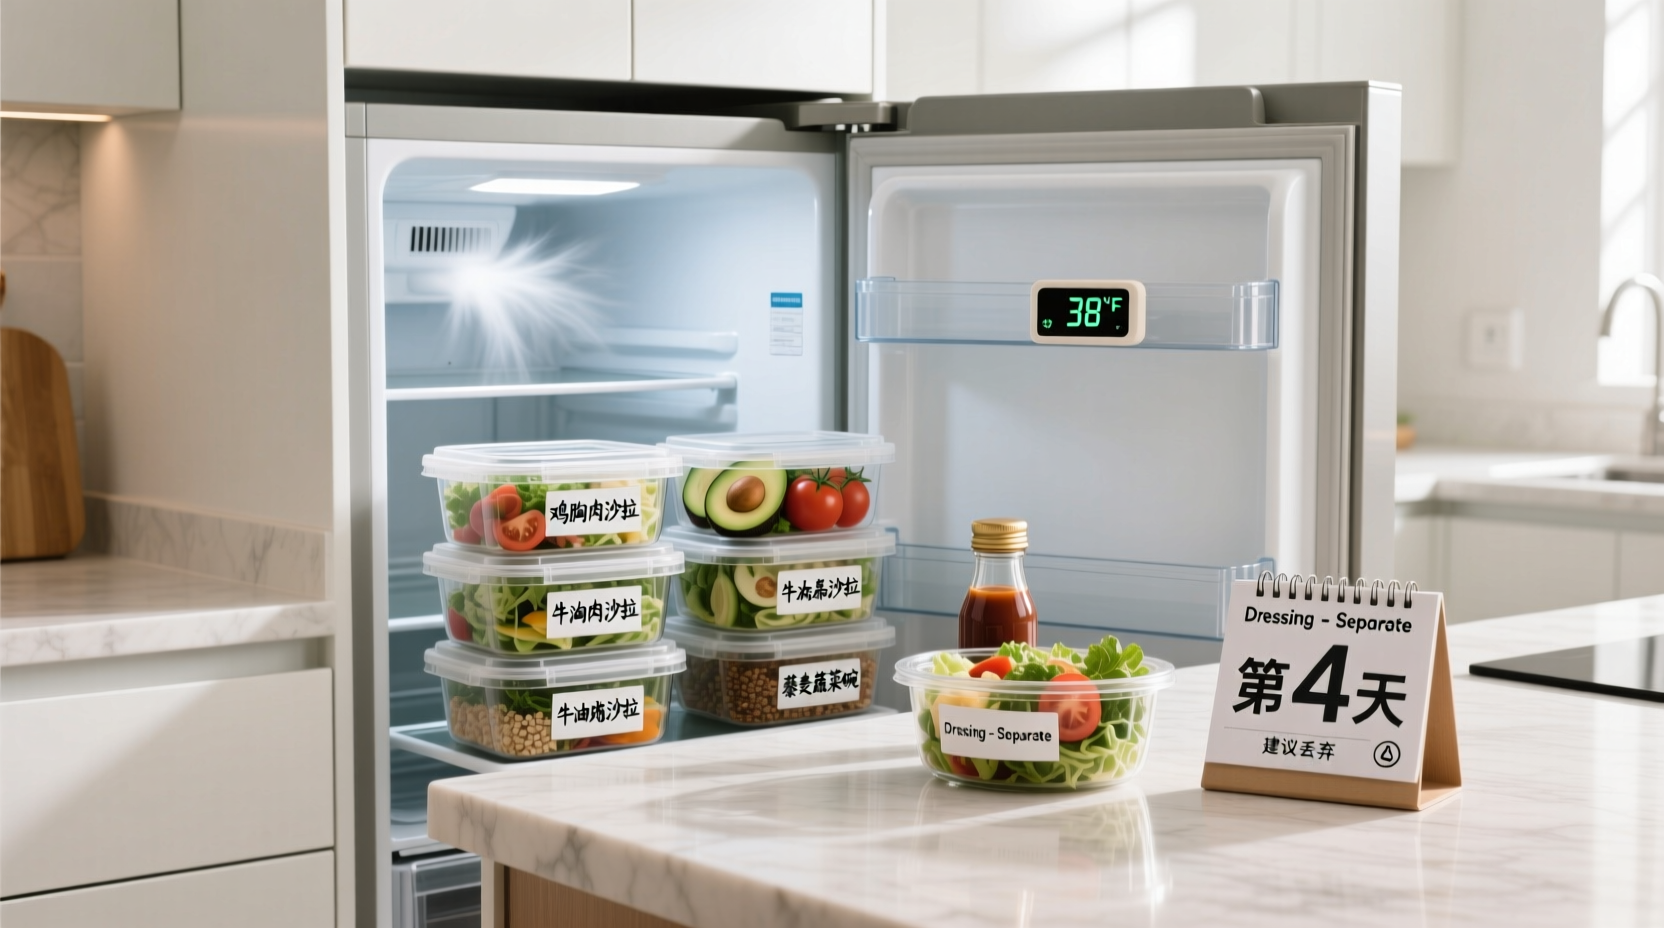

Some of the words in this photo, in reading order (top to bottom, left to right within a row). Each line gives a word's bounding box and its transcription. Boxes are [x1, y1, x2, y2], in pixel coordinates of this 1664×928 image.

[550, 498, 640, 525] 鸡胸肉沙拉
[1244, 606, 1315, 630] Dressing
[1336, 612, 1413, 634] Separate
